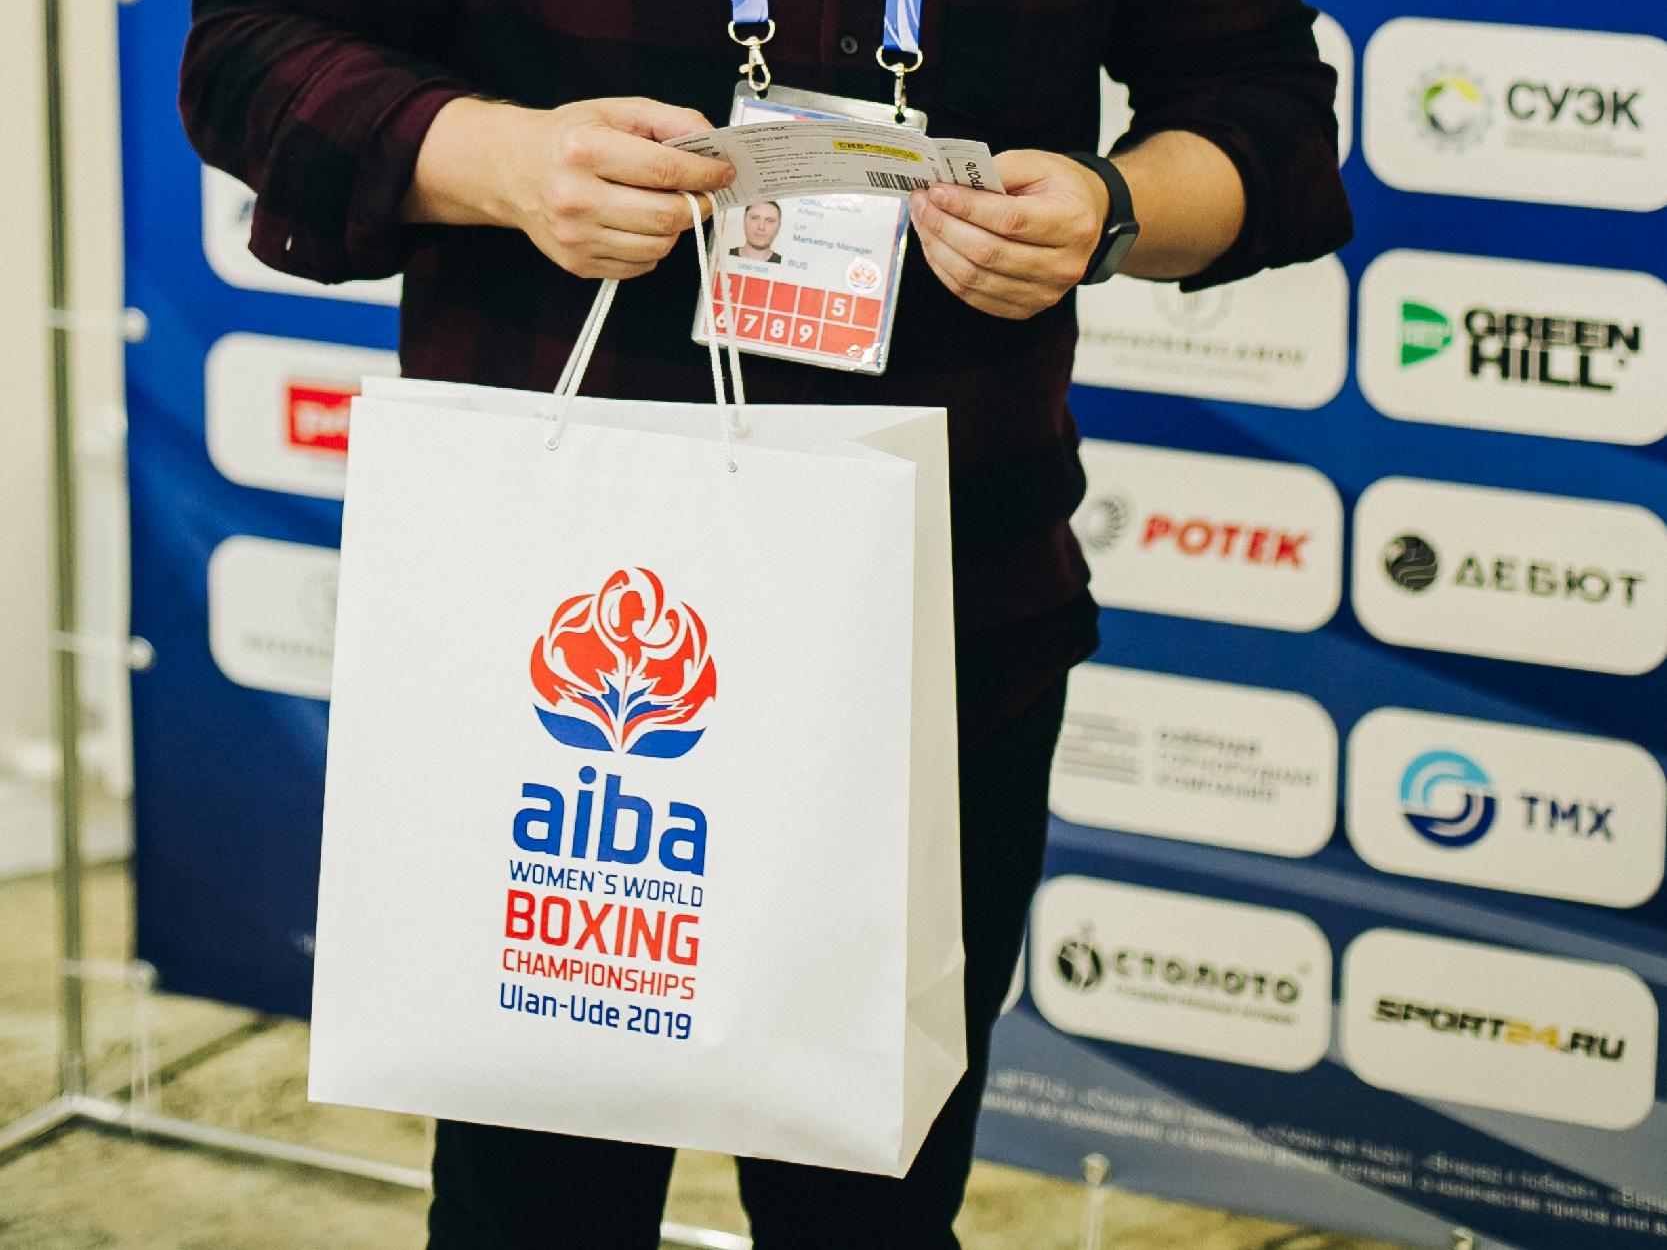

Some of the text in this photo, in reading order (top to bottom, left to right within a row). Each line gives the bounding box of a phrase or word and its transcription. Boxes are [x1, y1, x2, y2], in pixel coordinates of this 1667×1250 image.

[1506, 82, 1645, 129] СУЭК
[788, 259, 808, 270] RUS
[743, 314, 759, 333] 7
[769, 318, 785, 338] 8
[799, 324, 813, 343] 9
[831, 298, 846, 318] 5
[1464, 308, 1641, 353] GREEN
[1470, 342, 1613, 390] HILL
[1141, 514, 1310, 570] РОТЕК
[1453, 553, 1646, 608] ДЕБЮТ
[512, 765, 707, 877] aiba
[623, 875, 703, 908] WORLD
[504, 888, 700, 966] BOXING
[502, 948, 696, 1000] CHAMPIONSHIPS
[1115, 951, 1299, 1004] СТОЛОТО
[500, 982, 692, 1040] Ulan-Ude 2019
[1375, 998, 1626, 1061] SPORT24.RU
